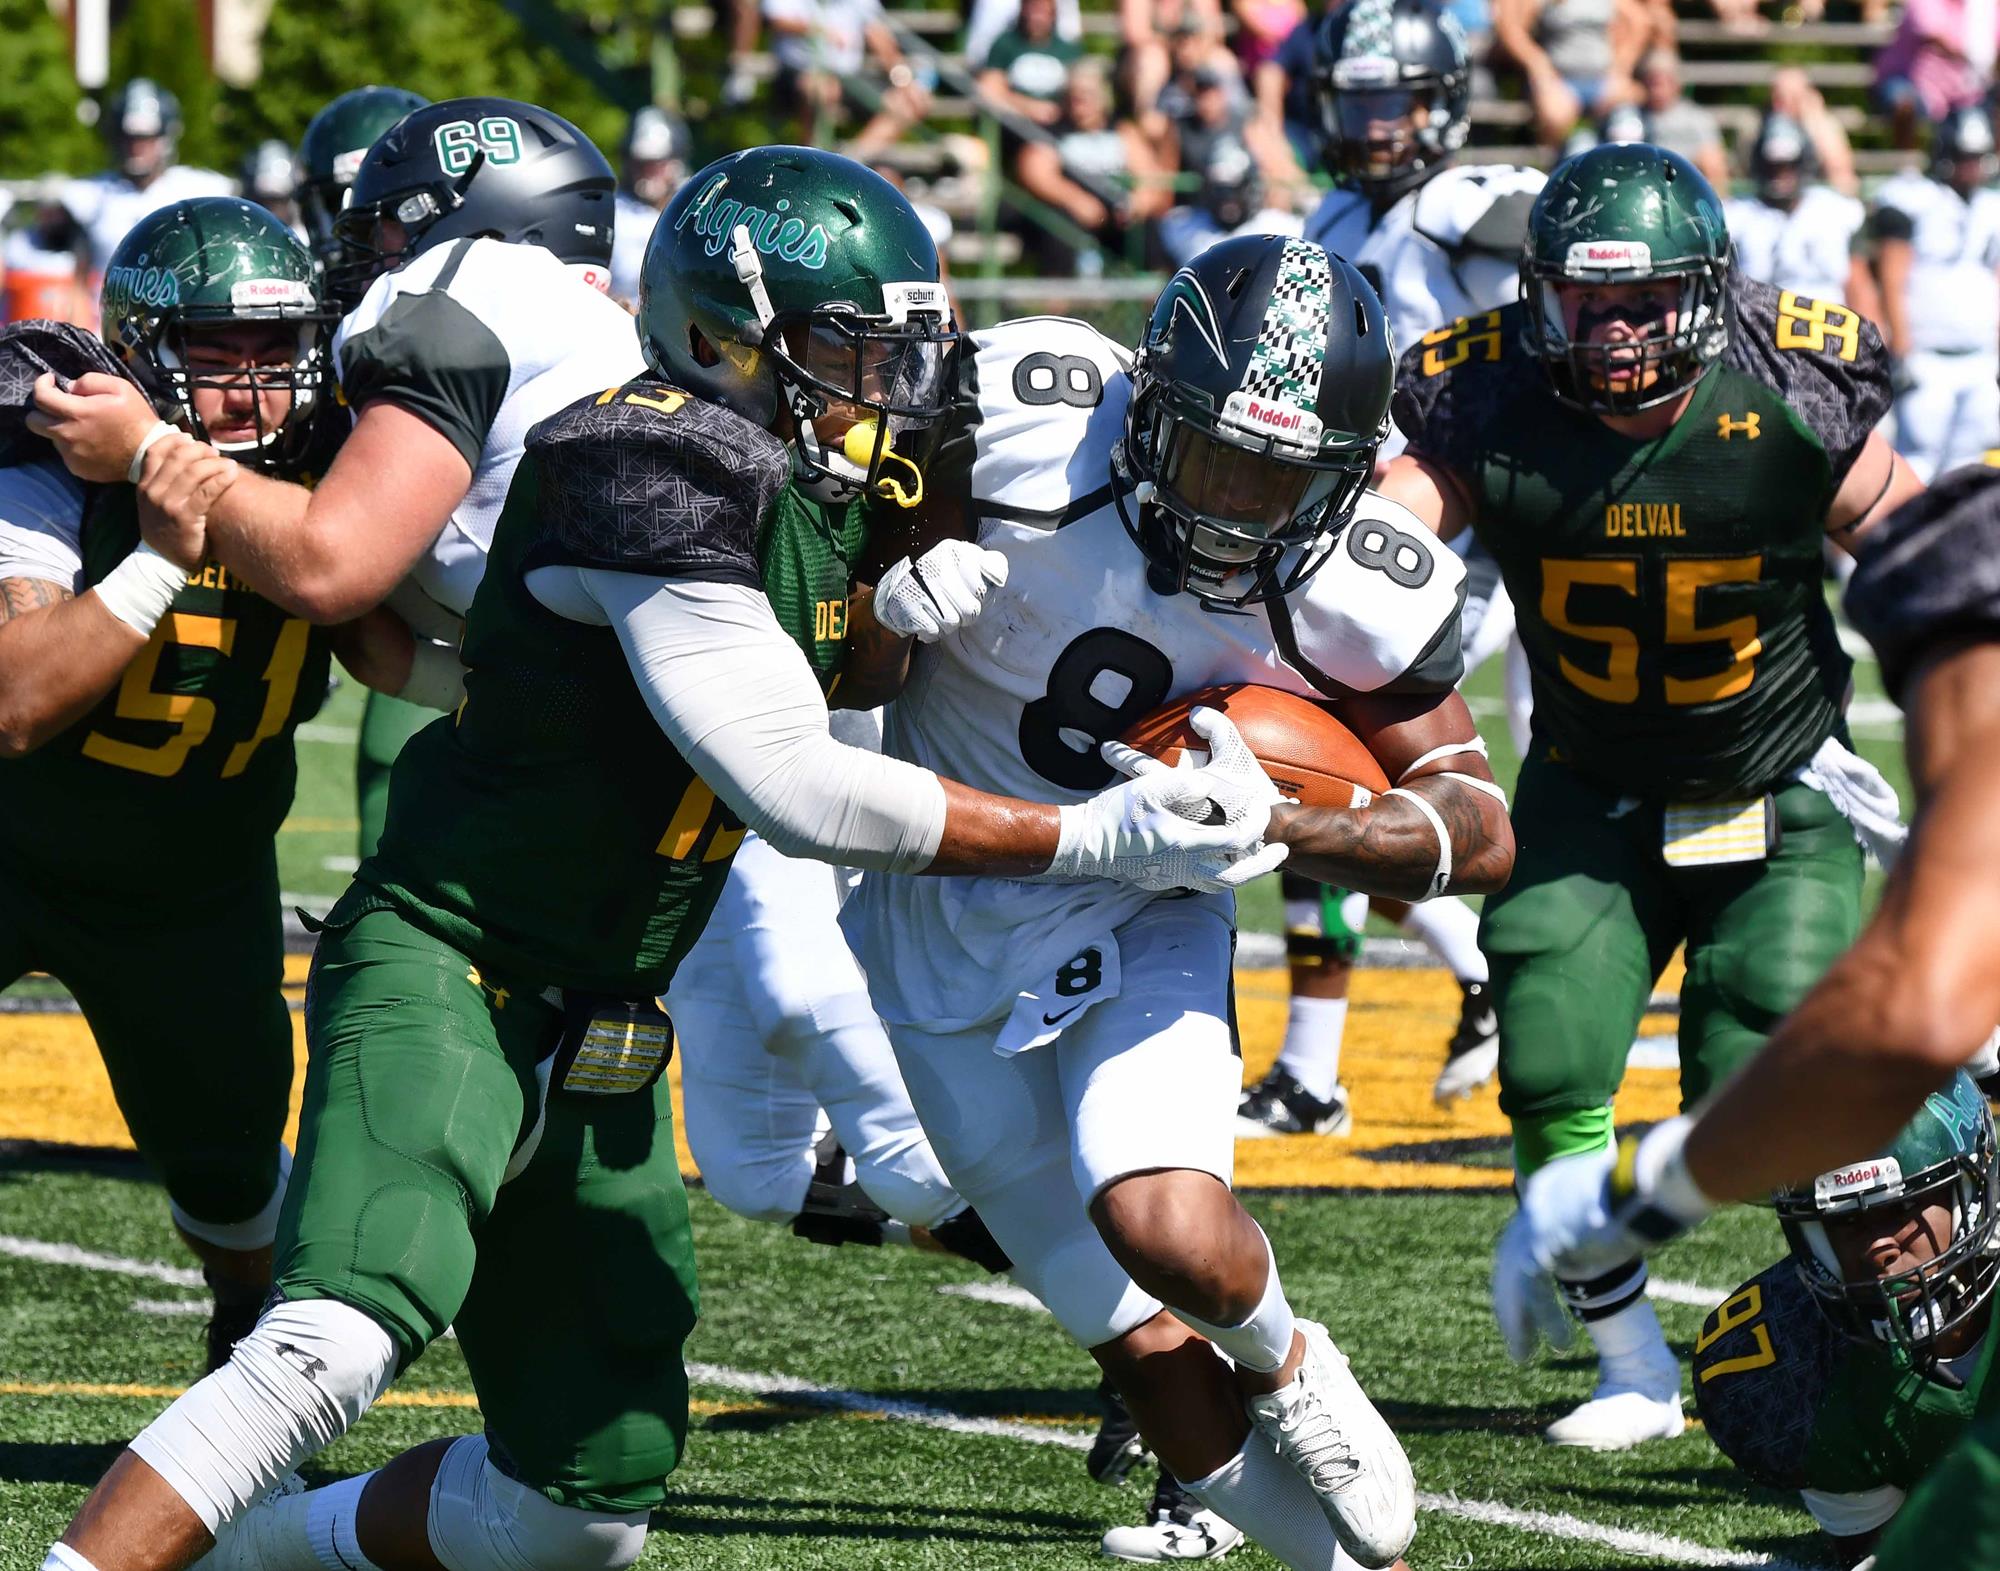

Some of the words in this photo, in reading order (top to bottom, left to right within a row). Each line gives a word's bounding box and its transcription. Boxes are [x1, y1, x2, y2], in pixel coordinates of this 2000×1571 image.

[434, 117, 522, 177] 69
[675, 172, 828, 270] Aggies
[1587, 247, 1632, 260] Riddell
[104, 254, 179, 318] ggies
[250, 284, 291, 296] Riddell
[907, 288, 935, 301] schutt
[1776, 289, 1860, 362] 55
[1012, 351, 1104, 408] 8
[1246, 402, 1302, 430] Riddell
[1605, 503, 1687, 537] DELVAL
[1346, 519, 1434, 589] 8
[1541, 554, 1763, 704] 55
[81, 612, 311, 779] 51
[1019, 627, 1174, 790] 8
[1056, 949, 1102, 997] 8
[1834, 1164, 1880, 1187] Riddell
[1696, 1285, 1777, 1384] 97
